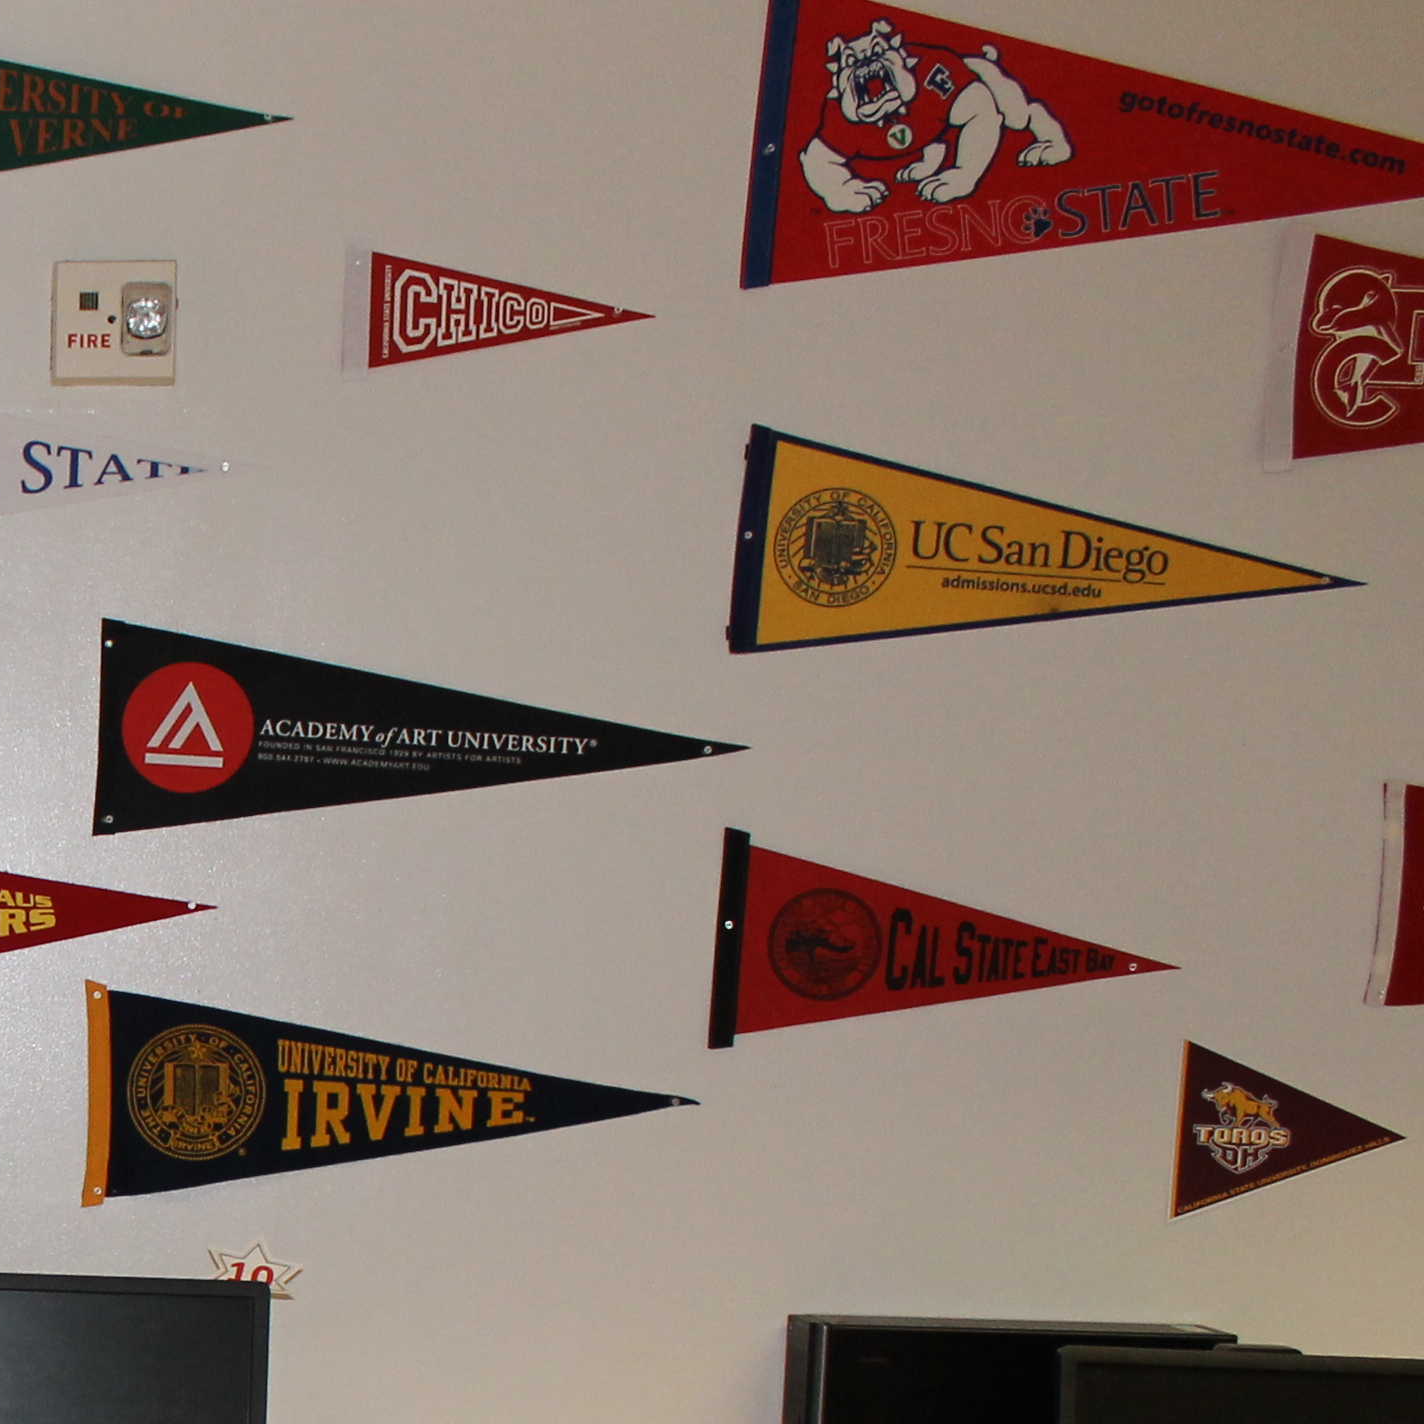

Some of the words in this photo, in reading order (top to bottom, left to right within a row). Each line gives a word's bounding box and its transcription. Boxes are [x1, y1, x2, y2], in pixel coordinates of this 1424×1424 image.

[9, 118, 139, 157] VERNE
[1118, 89, 1407, 175] gotofresnostate.com
[823, 195, 1050, 269] FRESNO
[1057, 171, 1223, 239] STATE
[393, 268, 548, 354] CHICO
[67, 333, 112, 349] FIRE
[777, 493, 822, 569] UNIVERSITY
[830, 491, 850, 501] OF
[857, 496, 894, 576] CALIFORNIA
[911, 519, 974, 562] UC
[978, 525, 1051, 568] San
[1059, 530, 1170, 584] Diego
[941, 575, 1102, 598] admissions.ucsd.edu
[258, 741, 300, 751] FOUNDED
[303, 743, 312, 751] IN
[315, 744, 333, 752] SAN
[335, 746, 386, 756] FRANCISCO
[426, 752, 462, 761] ARTISTS
[464, 754, 483, 762] FOR
[485, 756, 522, 765] ARTISTS
[259, 718, 374, 743] ACADEMY
[375, 727, 397, 748] of
[396, 728, 442, 747] ART
[885, 908, 945, 991] CAL
[953, 921, 1028, 985] STATE
[1031, 936, 1082, 978] EAST
[1085, 947, 1116, 974] BAY
[137, 1033, 197, 1097] UNIVERSITY
[209, 1036, 229, 1049] OF
[277, 1038, 392, 1084] UNIVERSITY
[395, 1059, 418, 1083] OF
[422, 1060, 532, 1092] CALIFORNIA
[140, 1110, 162, 1136] THE
[227, 1053, 256, 1136] CALIFORNIA
[280, 1077, 527, 1151] IRVINE
[1194, 1126, 1290, 1146] TOROS
[1177, 1190, 1228, 1213] CALIFORNIA
[1229, 1181, 1256, 1196] STATE
[1310, 1146, 1363, 1168] DOMINGUEZ
[1364, 1136, 1391, 1150] HILLS
[224, 1261, 275, 1285] 10
